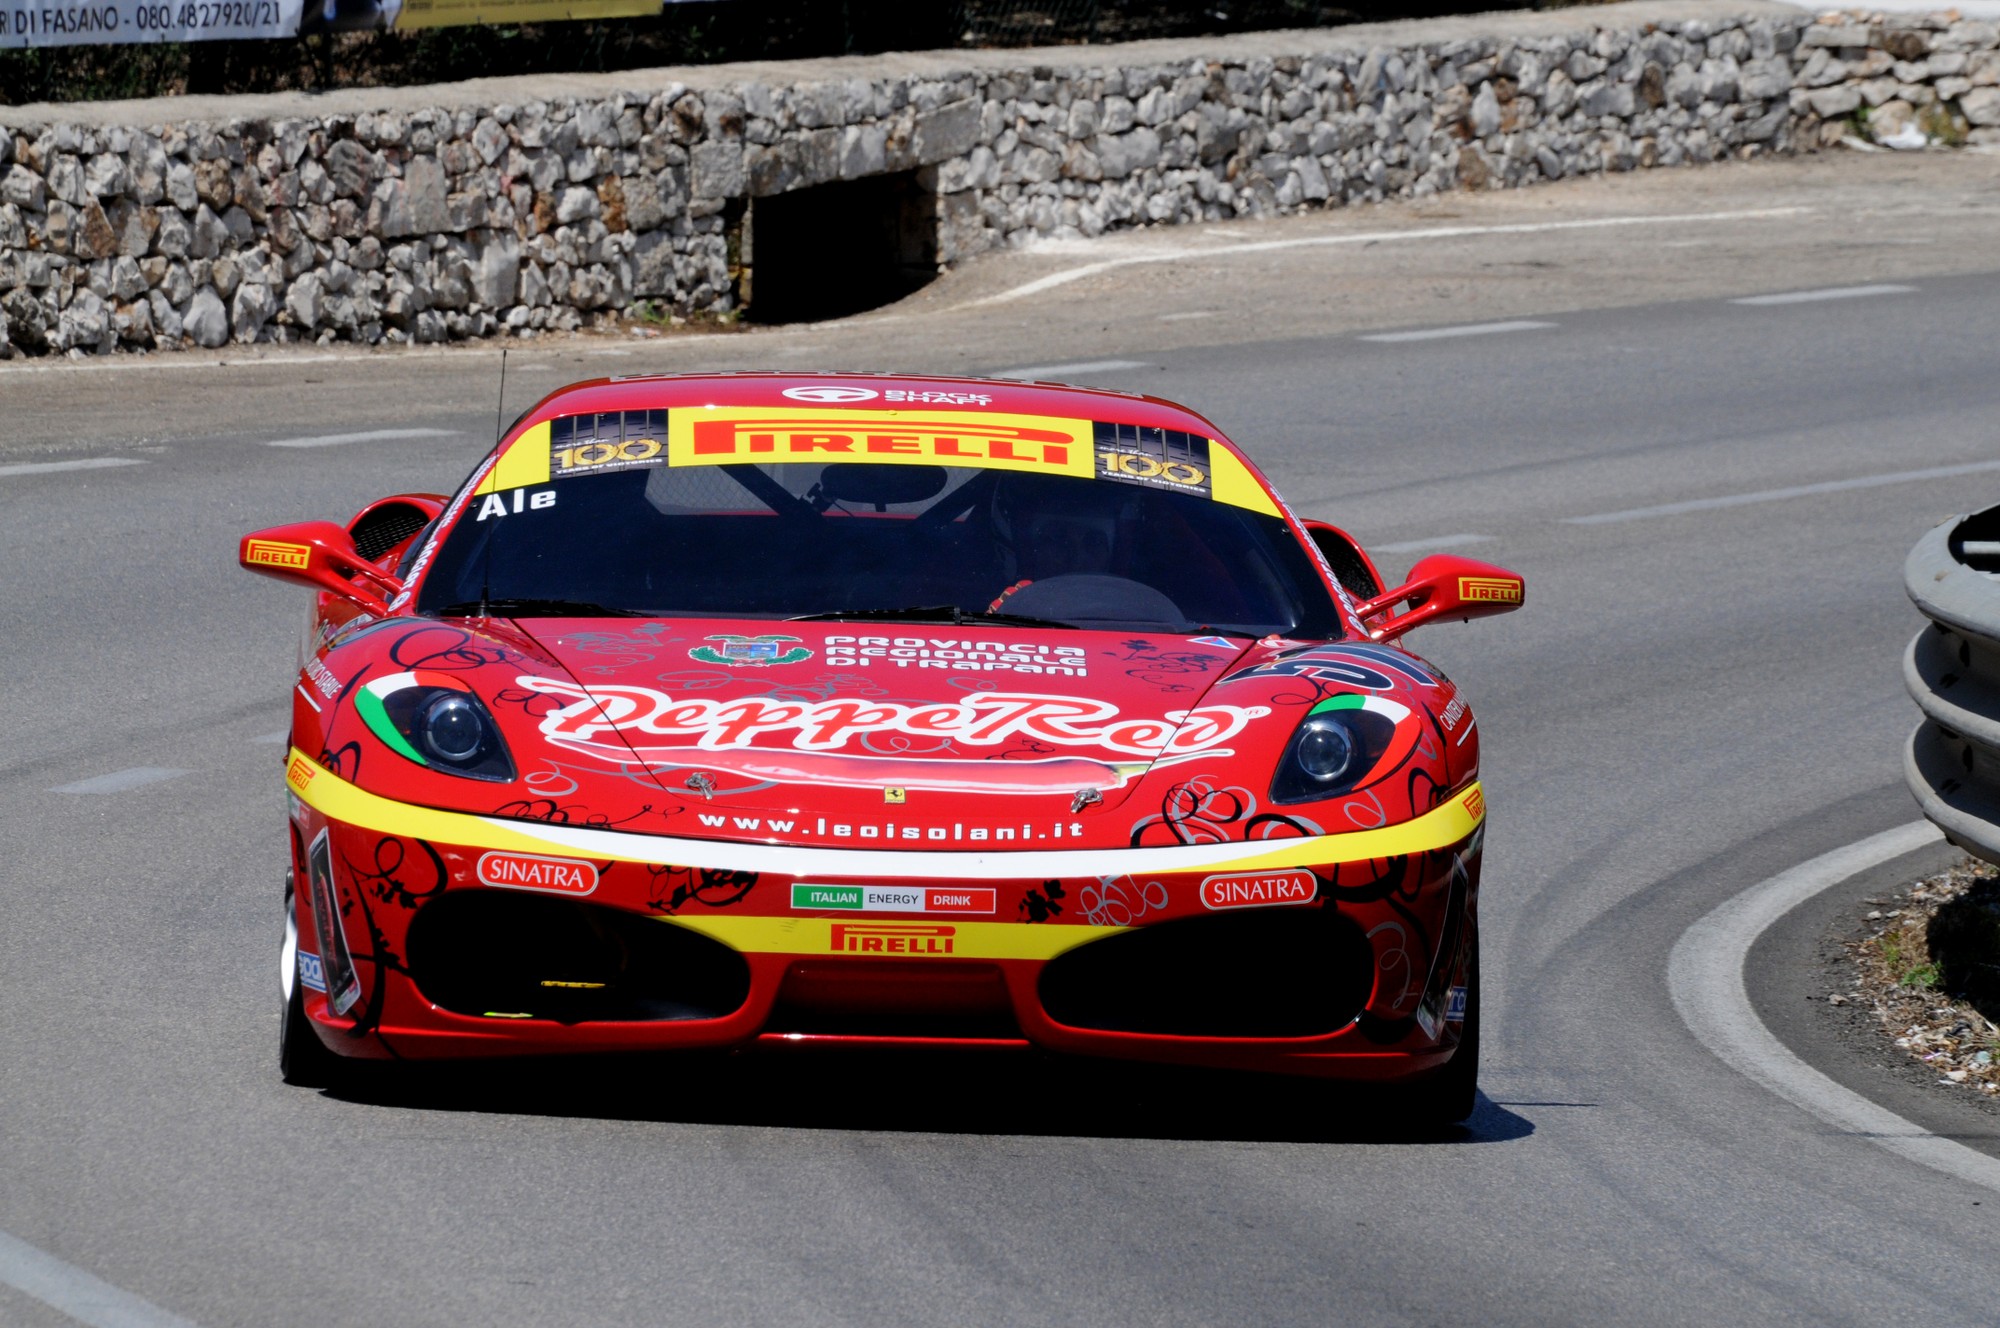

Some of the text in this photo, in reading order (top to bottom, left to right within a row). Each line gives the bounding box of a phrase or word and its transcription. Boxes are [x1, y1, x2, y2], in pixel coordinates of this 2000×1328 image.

[15, 10, 34, 34] DI
[42, 7, 118, 33] FASANO
[137, 2, 280, 30] 080.4827920/21
[554, 439, 662, 468] 100
[694, 418, 1074, 467] PIRELLI
[1099, 453, 1205, 485] 100
[476, 488, 556, 521] Ale
[250, 542, 309, 567] PIRELLI
[1462, 579, 1520, 602] PIRELLI
[825, 656, 870, 667] DI
[288, 757, 316, 791] PIRELLI
[698, 813, 1083, 841] www.leoisolani.it
[490, 858, 584, 888] SINATRA
[810, 891, 971, 907] ITALIAN ENERGY DRINK
[1213, 876, 1306, 904] SINATRA
[830, 924, 956, 954] PIRELLI
